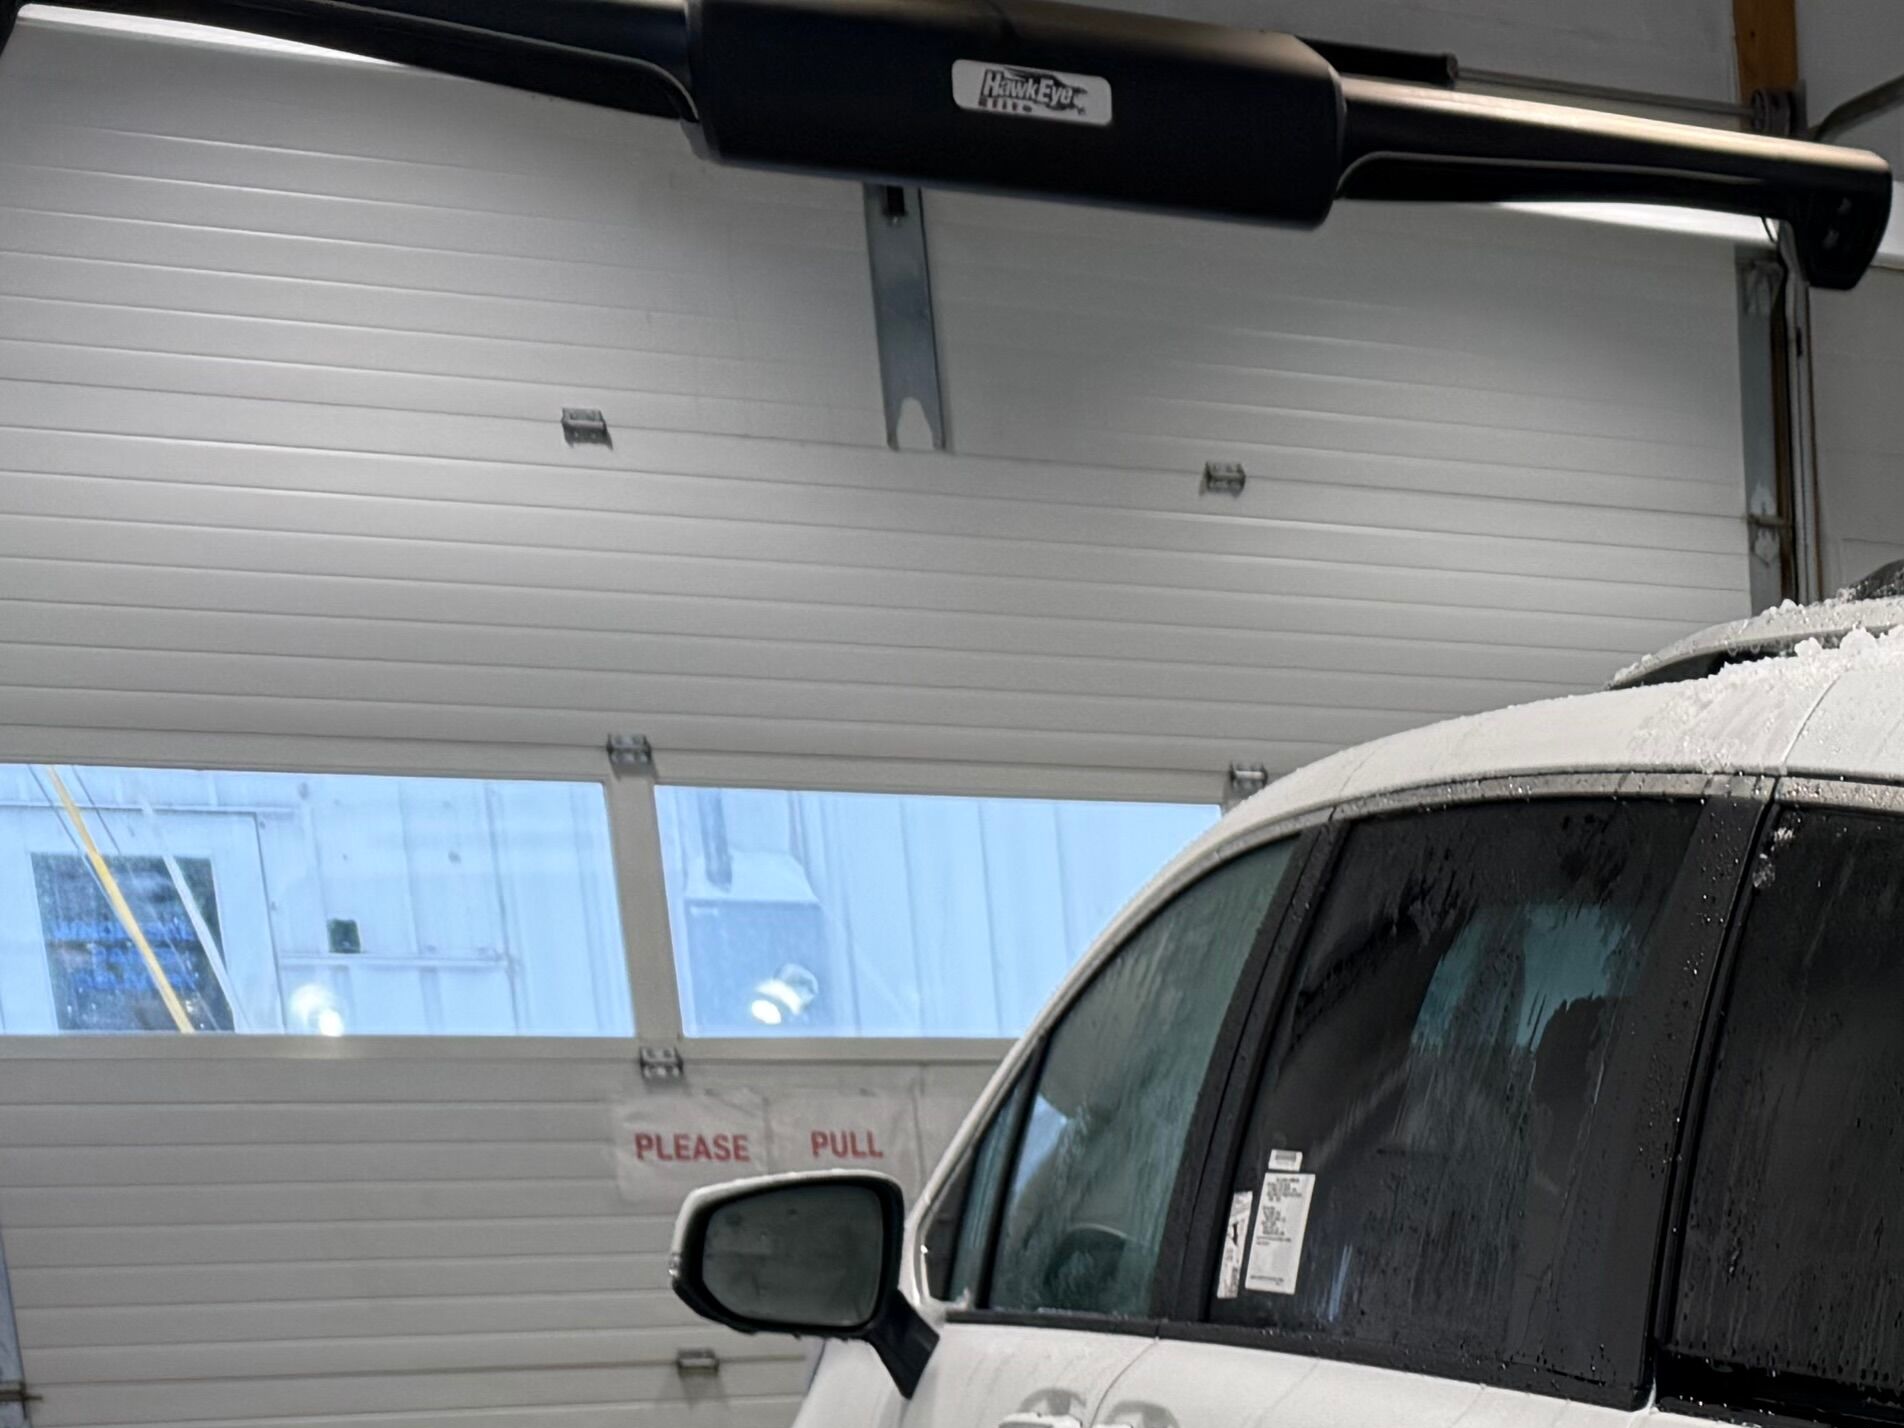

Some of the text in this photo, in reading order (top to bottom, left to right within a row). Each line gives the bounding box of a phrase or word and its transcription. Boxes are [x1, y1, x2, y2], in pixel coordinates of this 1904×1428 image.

[981, 68, 1074, 106] HawkEye
[634, 1130, 884, 1163] PLEASE PULL
